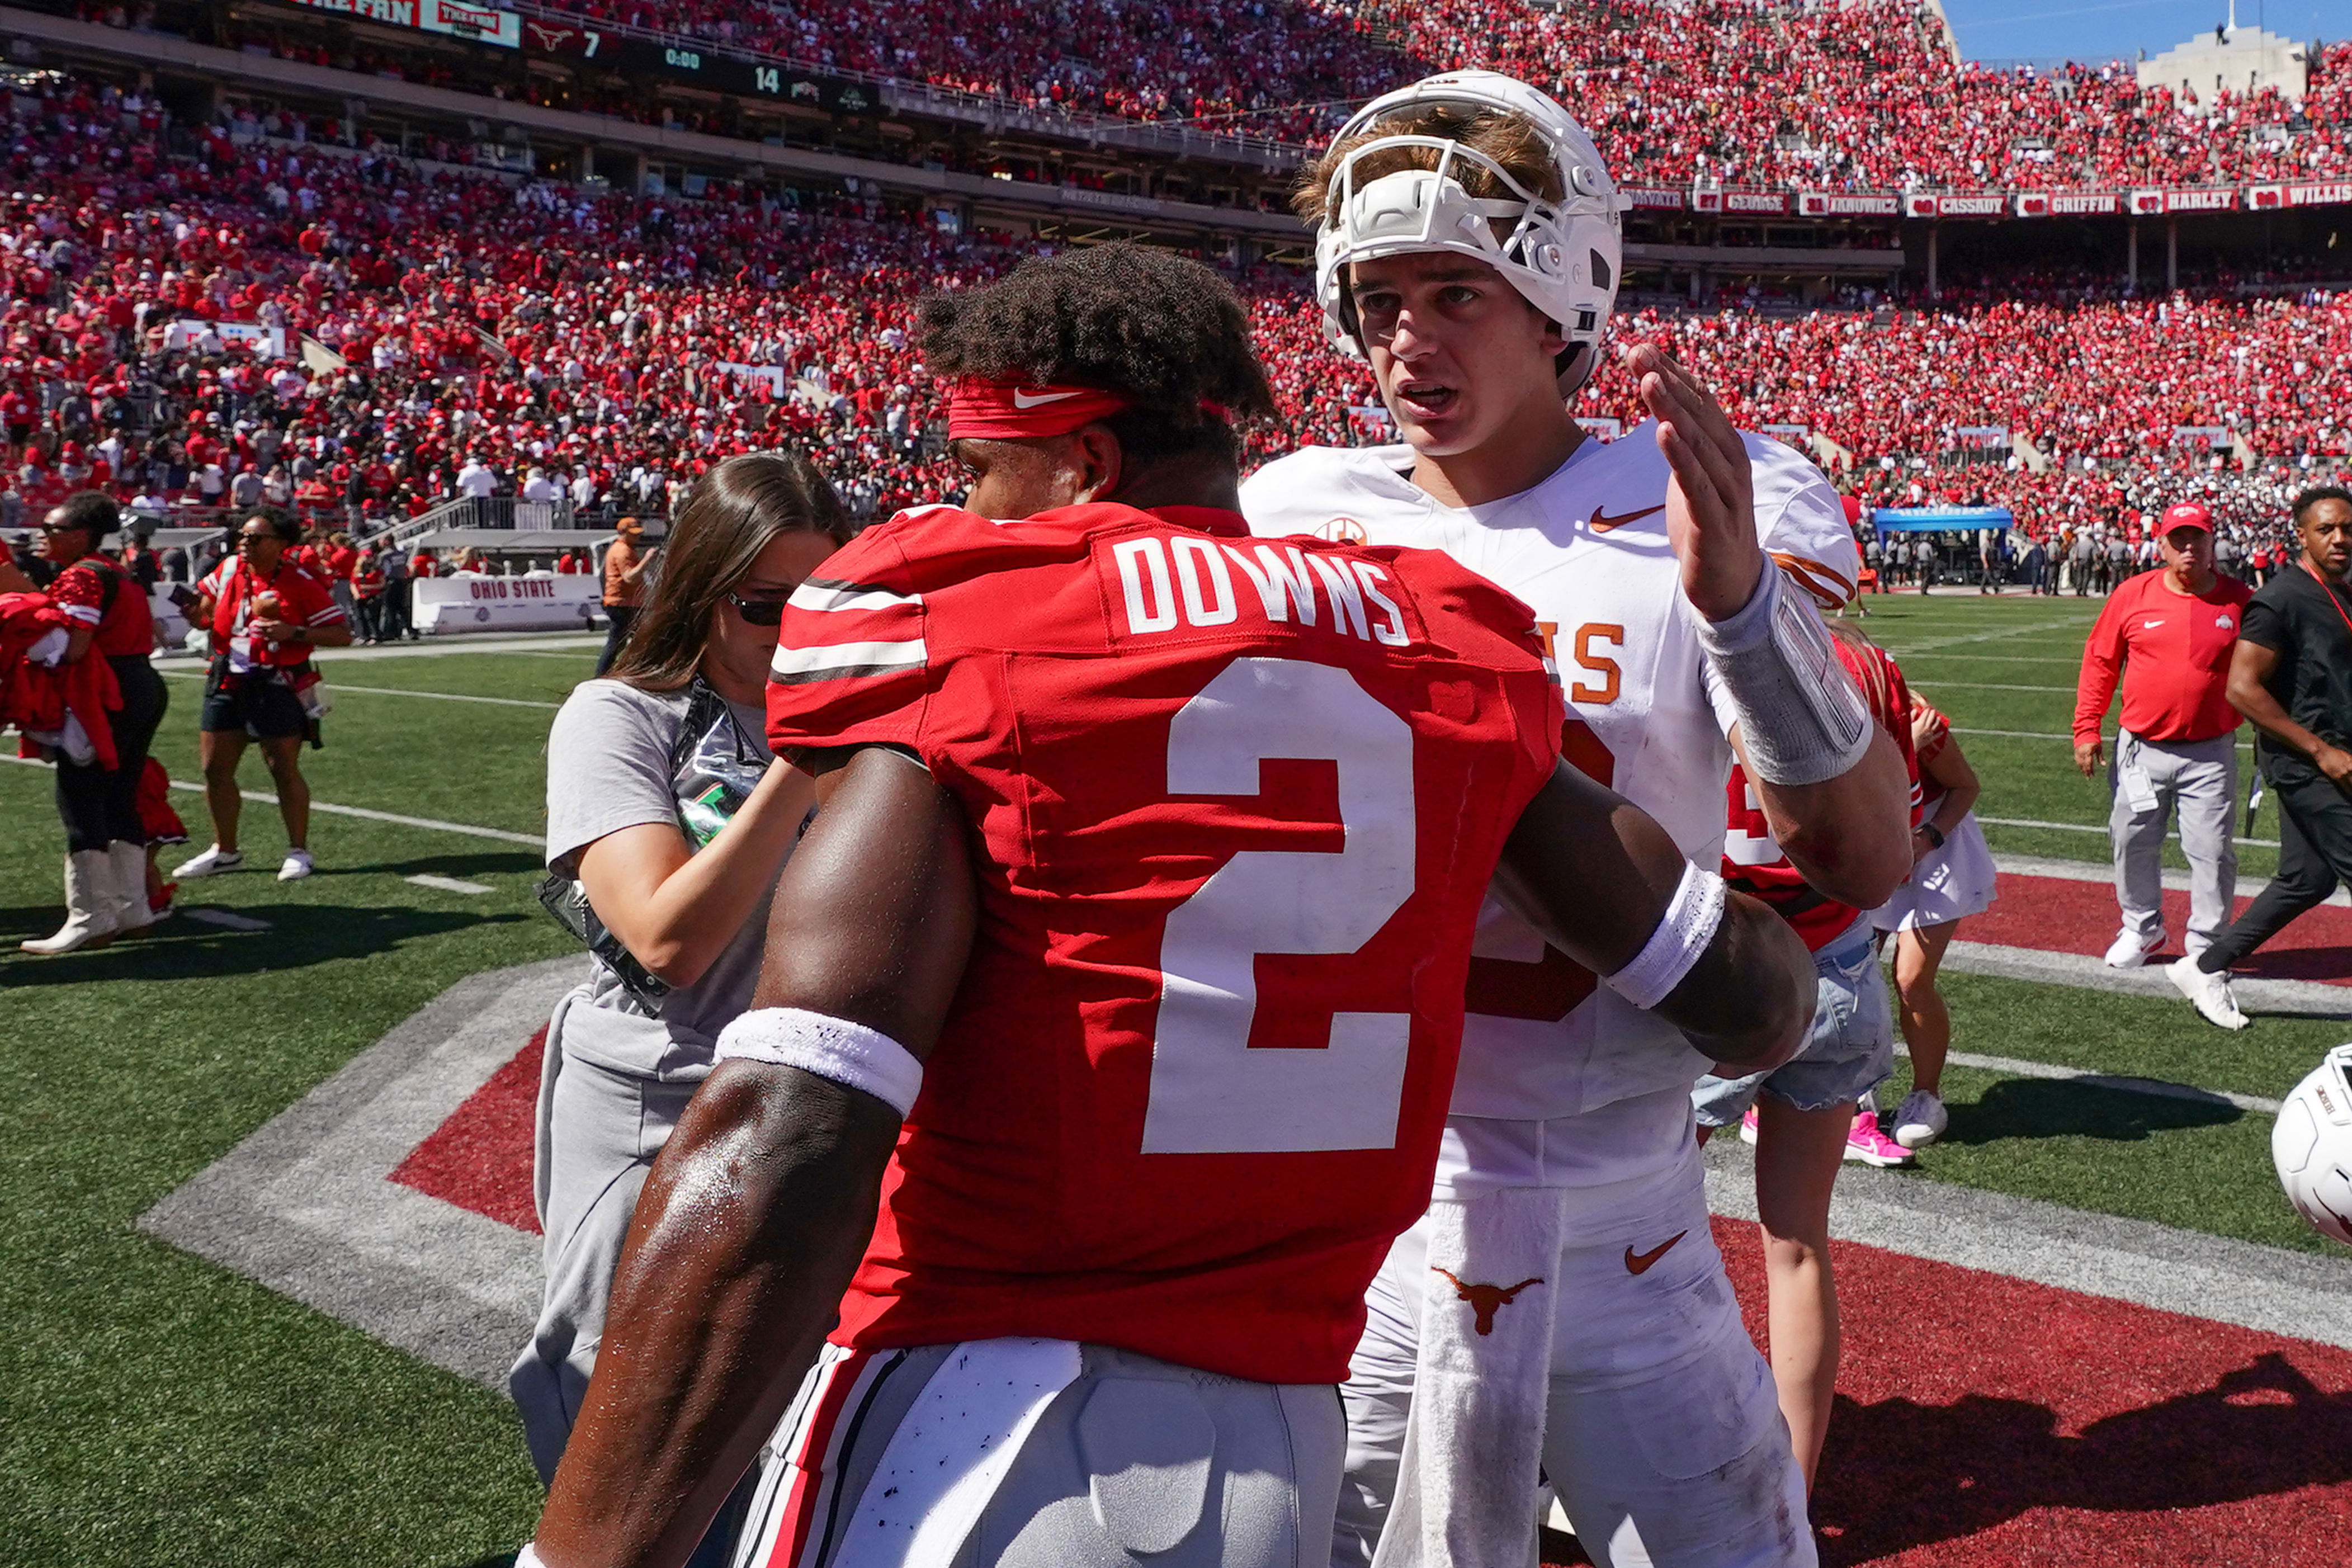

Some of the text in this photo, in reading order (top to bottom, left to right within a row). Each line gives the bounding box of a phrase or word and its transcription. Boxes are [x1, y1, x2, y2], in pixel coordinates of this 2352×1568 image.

[355, 0, 413, 26] FAN
[583, 31, 599, 57] 7
[665, 48, 700, 69] 0:00
[755, 66, 780, 94] 14
[1727, 193, 1784, 211] GEORGE
[2052, 196, 2116, 214] GRIFFIN
[2167, 191, 2232, 210] HARLEY
[2288, 184, 2352, 205] WILLIS
[1829, 197, 1898, 214] JANOWICZ
[1939, 197, 2004, 214] CASSADY
[470, 580, 556, 599] OHIO STATE
[1112, 536, 1411, 648] DOWNS
[1140, 657, 1416, 1155] 2
